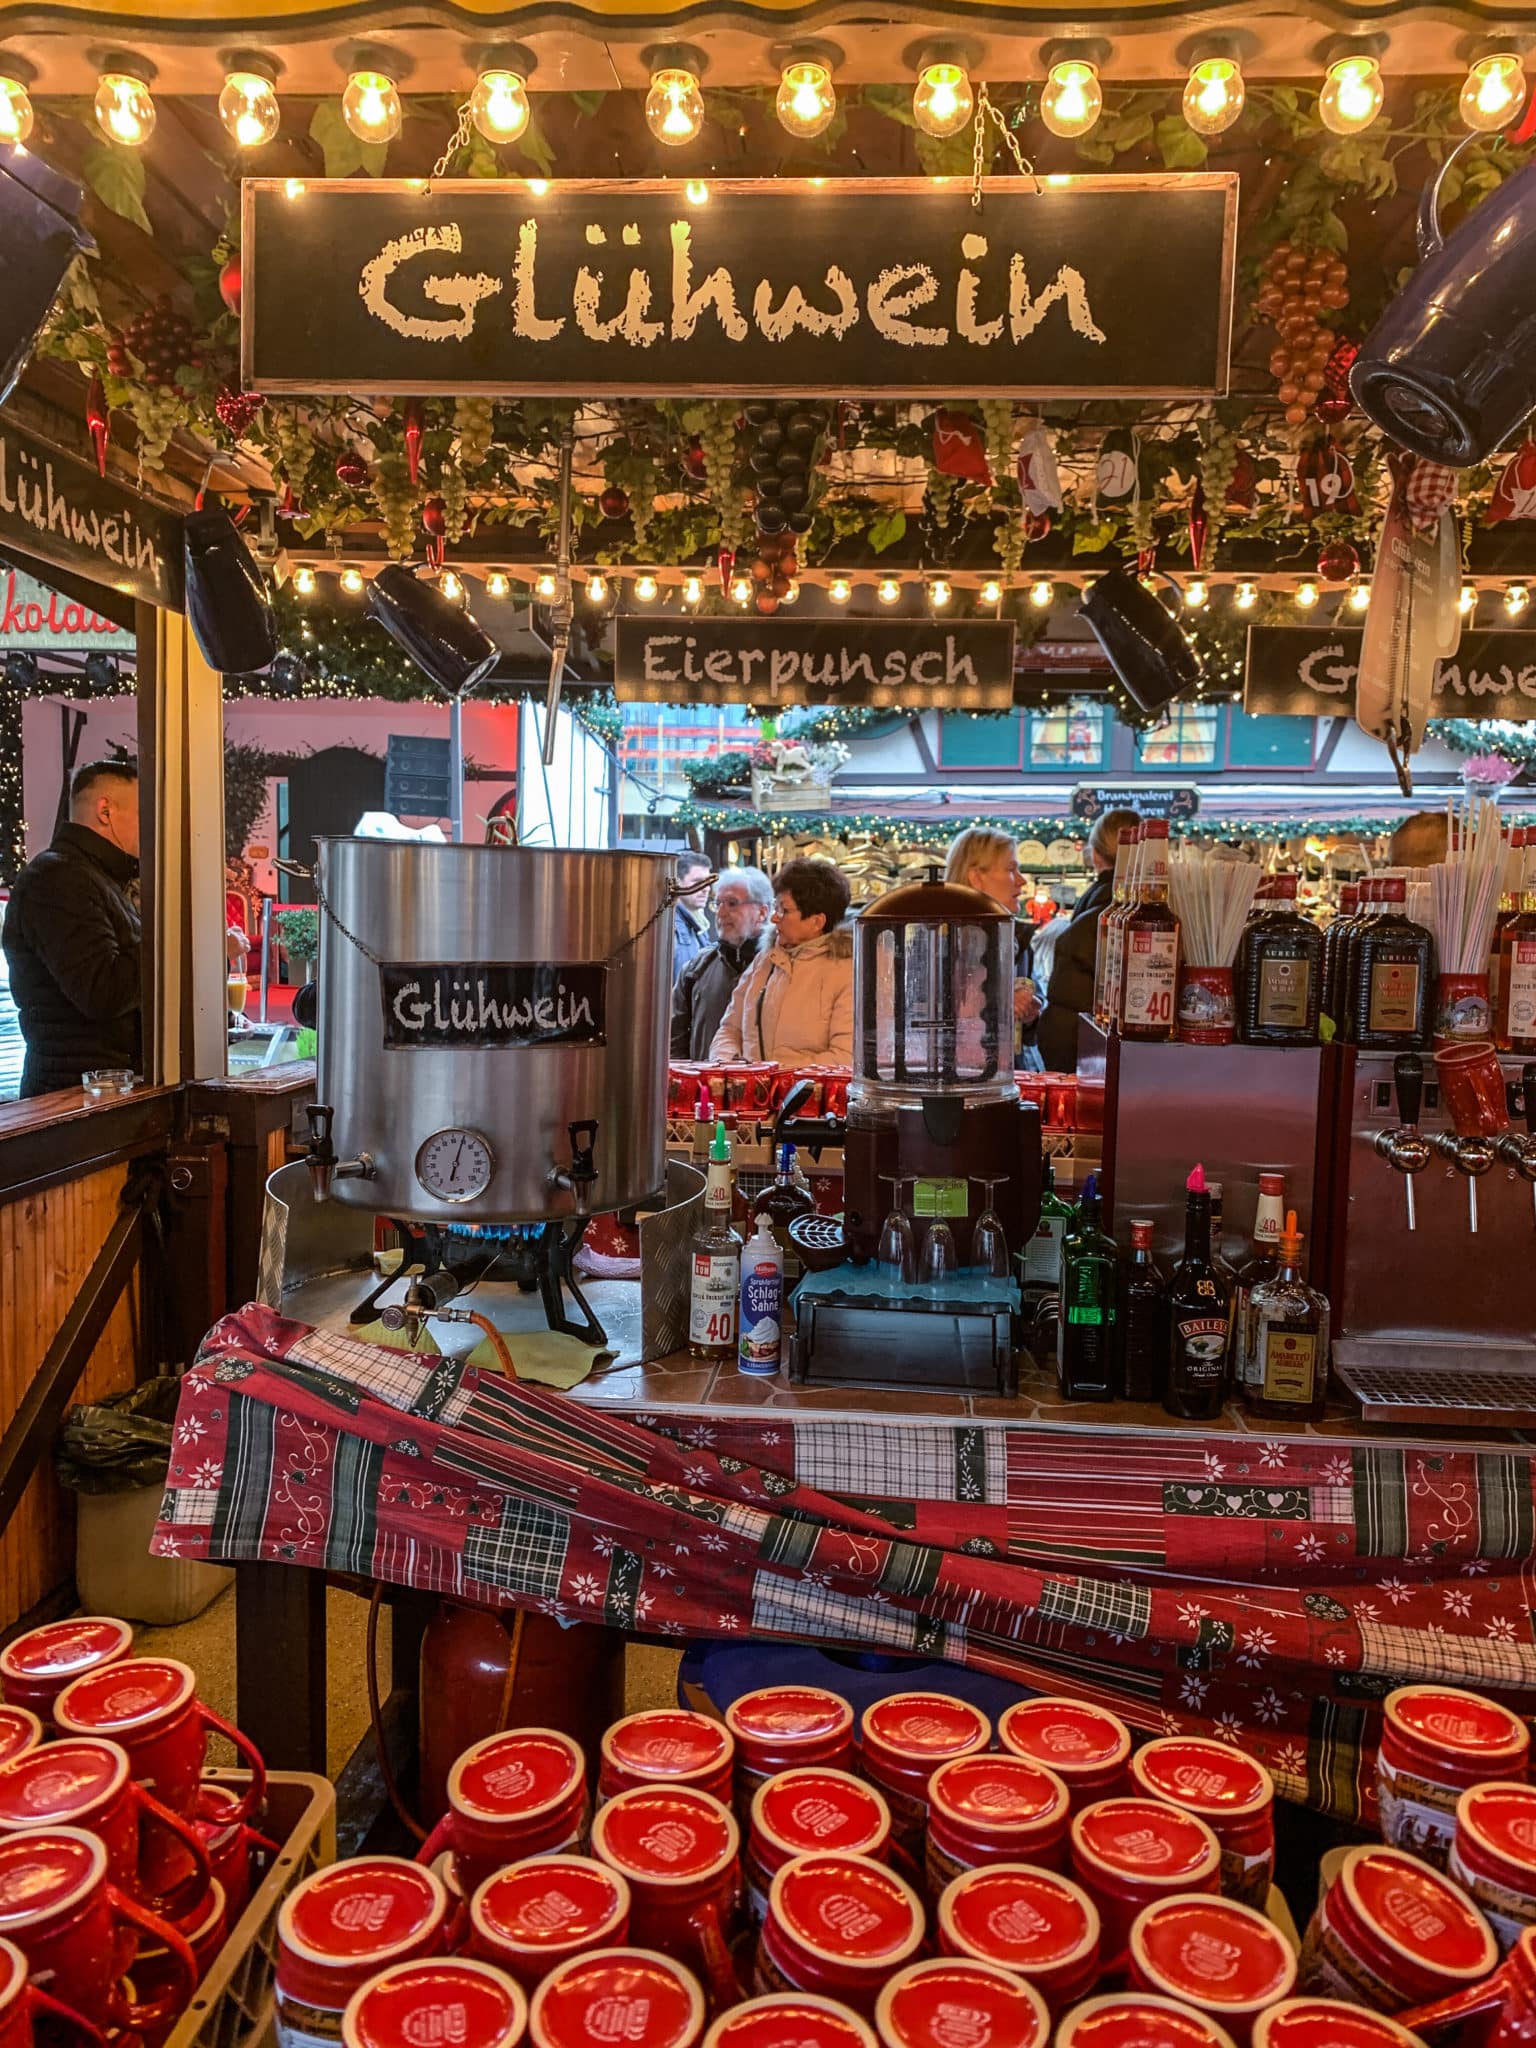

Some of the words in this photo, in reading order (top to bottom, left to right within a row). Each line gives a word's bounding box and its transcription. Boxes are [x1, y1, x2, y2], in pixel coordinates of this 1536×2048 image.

[359, 218, 1105, 347] Glühwein
[1305, 473, 1342, 507] 19
[643, 635, 978, 697] Eierpunsch
[1096, 789, 1174, 802] Brandmalerei
[393, 979, 595, 1032] Glühwein
[1146, 991, 1171, 1021] 40
[748, 1285, 781, 1301] Schlag-
[751, 1299, 779, 1312] Sahne
[706, 1312, 731, 1342] 40
[1183, 1321, 1228, 1334] BAILEYS
